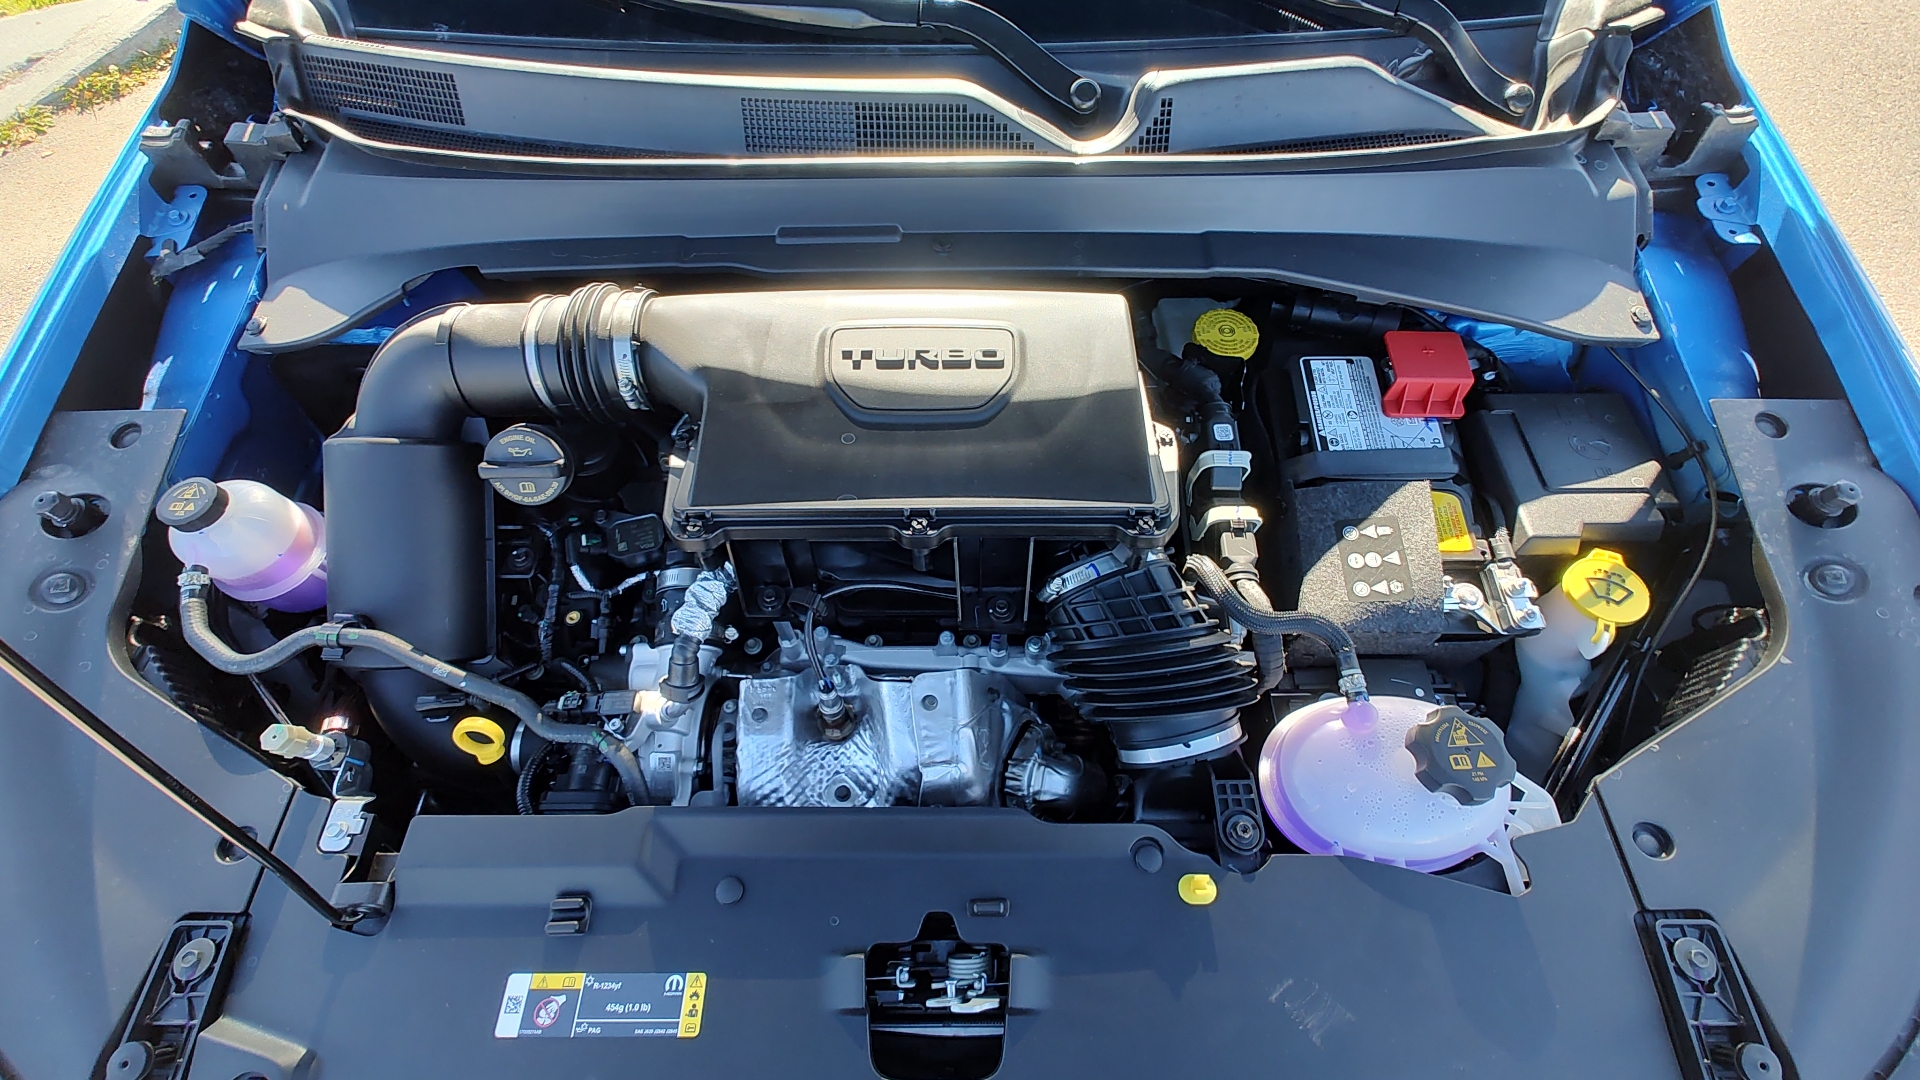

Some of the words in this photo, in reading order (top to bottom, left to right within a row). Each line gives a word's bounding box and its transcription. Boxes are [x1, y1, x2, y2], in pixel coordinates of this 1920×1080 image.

[841, 348, 1005, 370] TURBO
[499, 435, 524, 444] ENGINE
[525, 436, 536, 444] OIL
[494, 481, 505, 492] API
[593, 982, 622, 991] R-1234yf
[605, 1003, 624, 1014] 454g
[625, 1003, 639, 1013] (1.0
[640, 1003, 651, 1013] lb)
